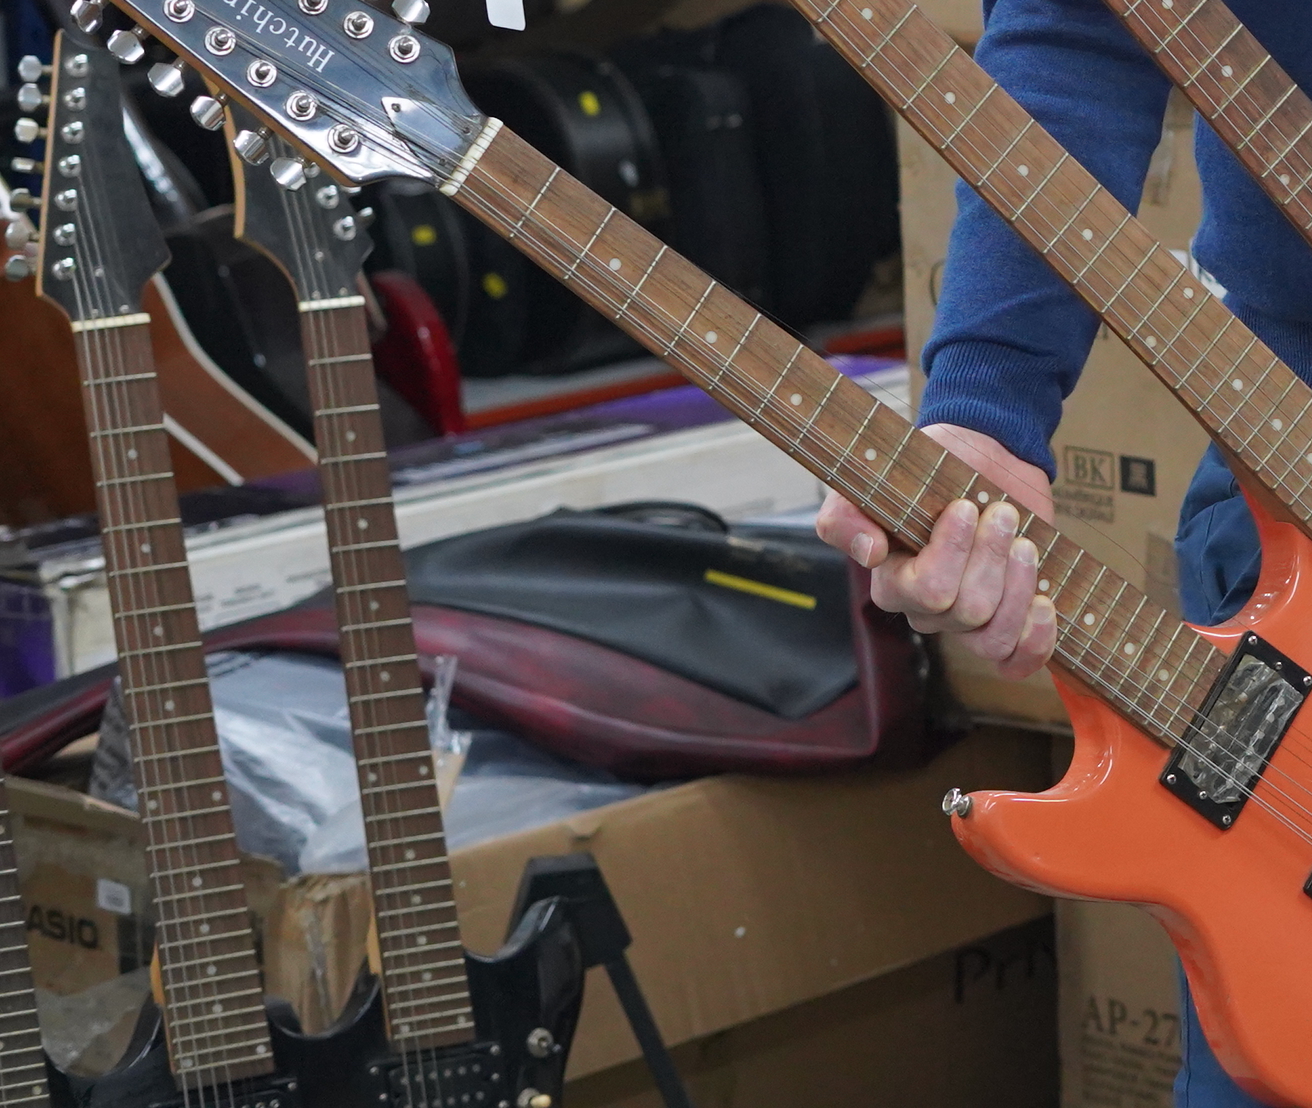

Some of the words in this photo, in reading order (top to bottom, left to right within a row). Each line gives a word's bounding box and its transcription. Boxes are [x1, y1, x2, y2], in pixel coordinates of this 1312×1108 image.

[1072, 453, 1107, 484] BK
[26, 904, 99, 949] ASIO
[1081, 995, 1179, 1047] AP-27
